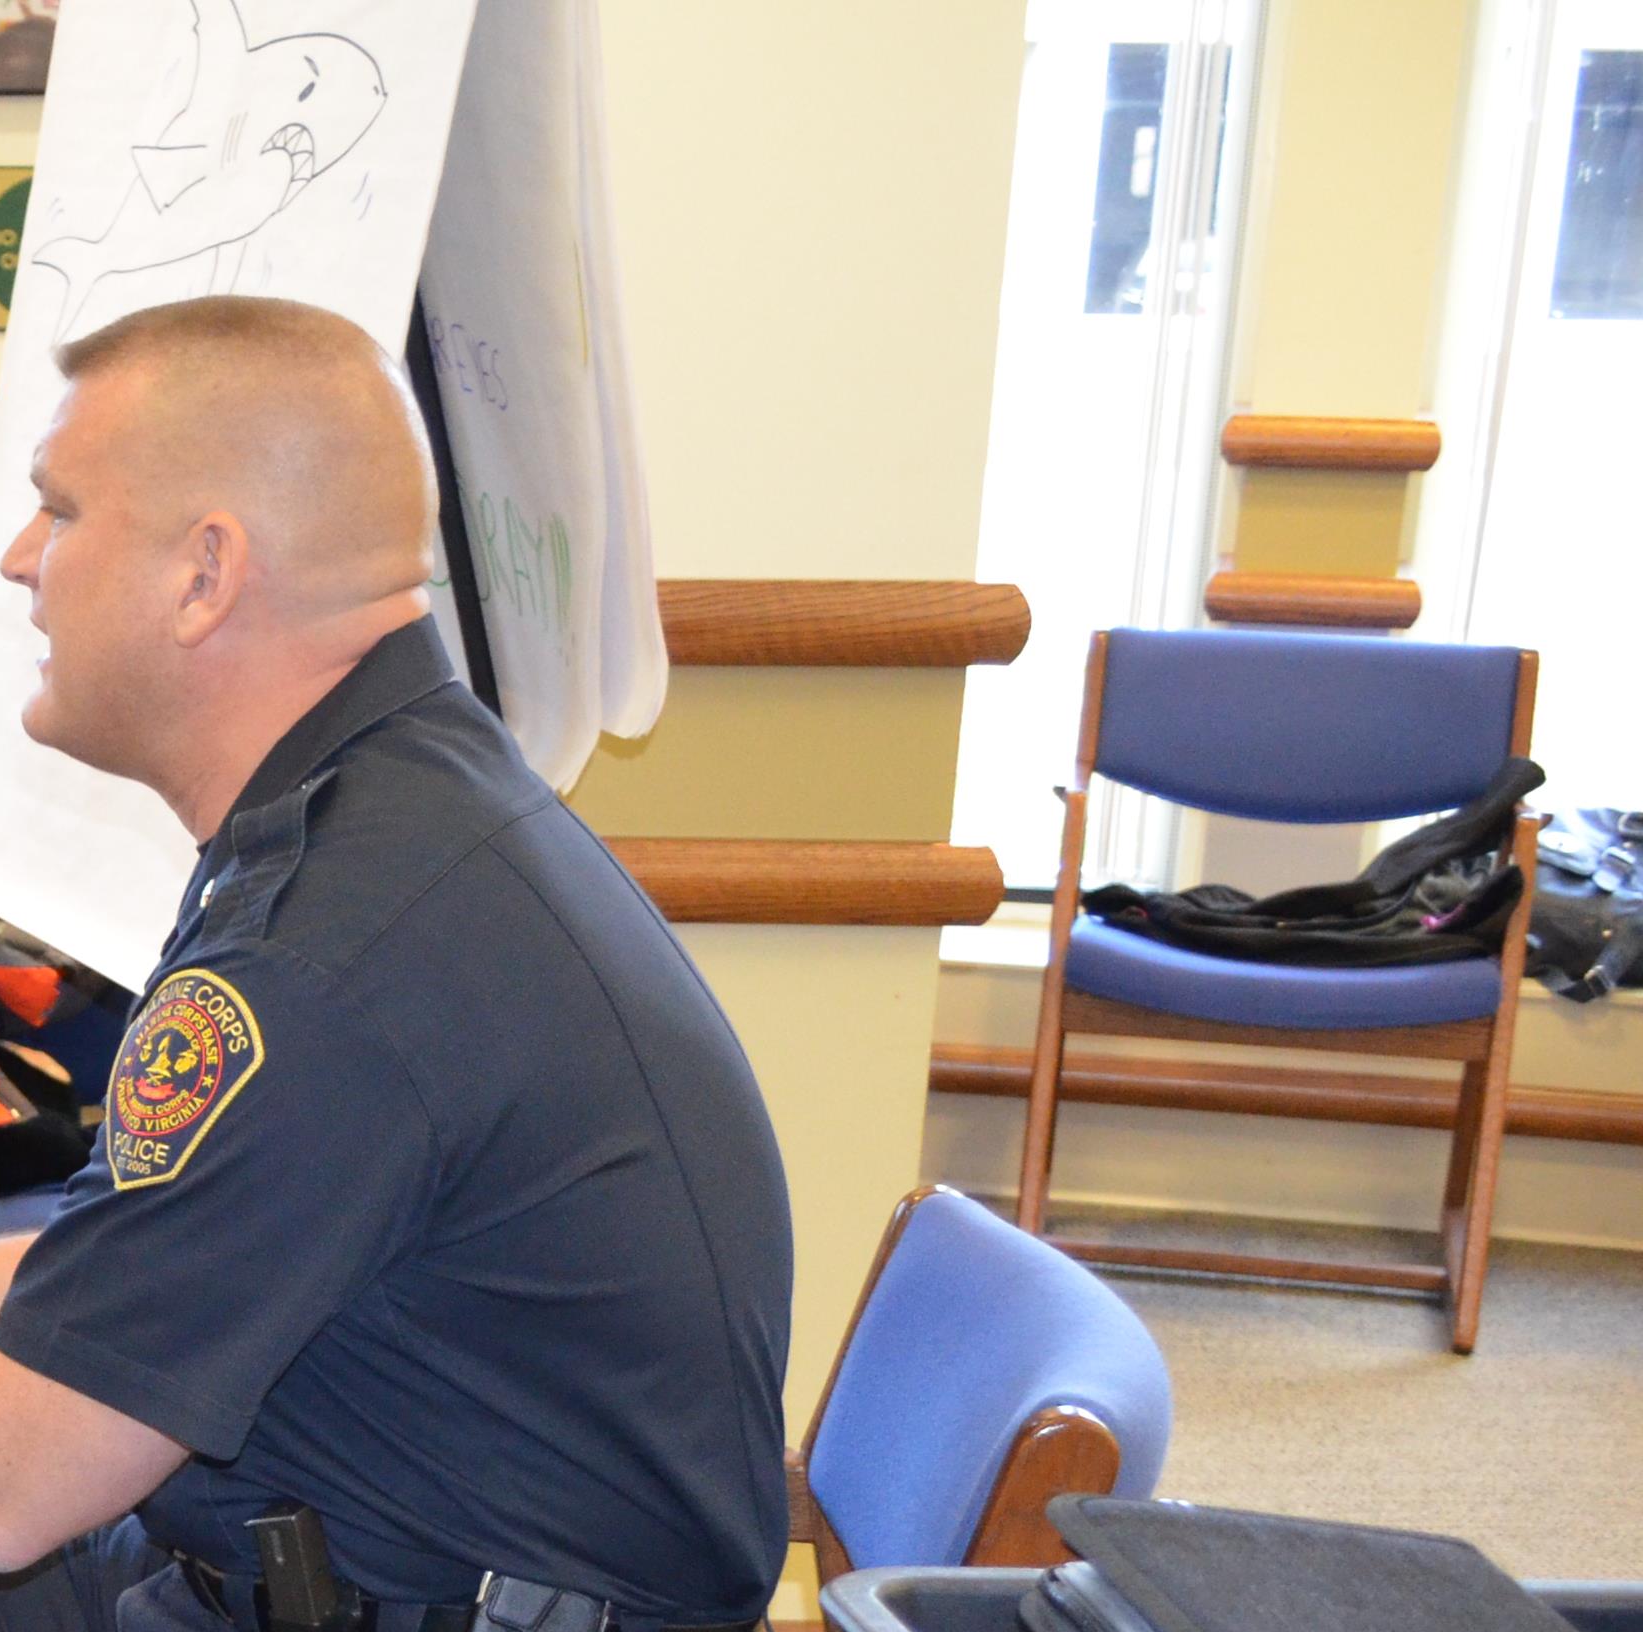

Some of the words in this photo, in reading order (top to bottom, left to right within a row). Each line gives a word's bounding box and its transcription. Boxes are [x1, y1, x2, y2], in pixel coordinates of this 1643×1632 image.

[173, 1005, 207, 1030] CORPS
[202, 1029, 219, 1065] BASE
[195, 985, 249, 1054] CORPS
[145, 1097, 206, 1131] VIRGINIA
[114, 1132, 170, 1166] POLICE
